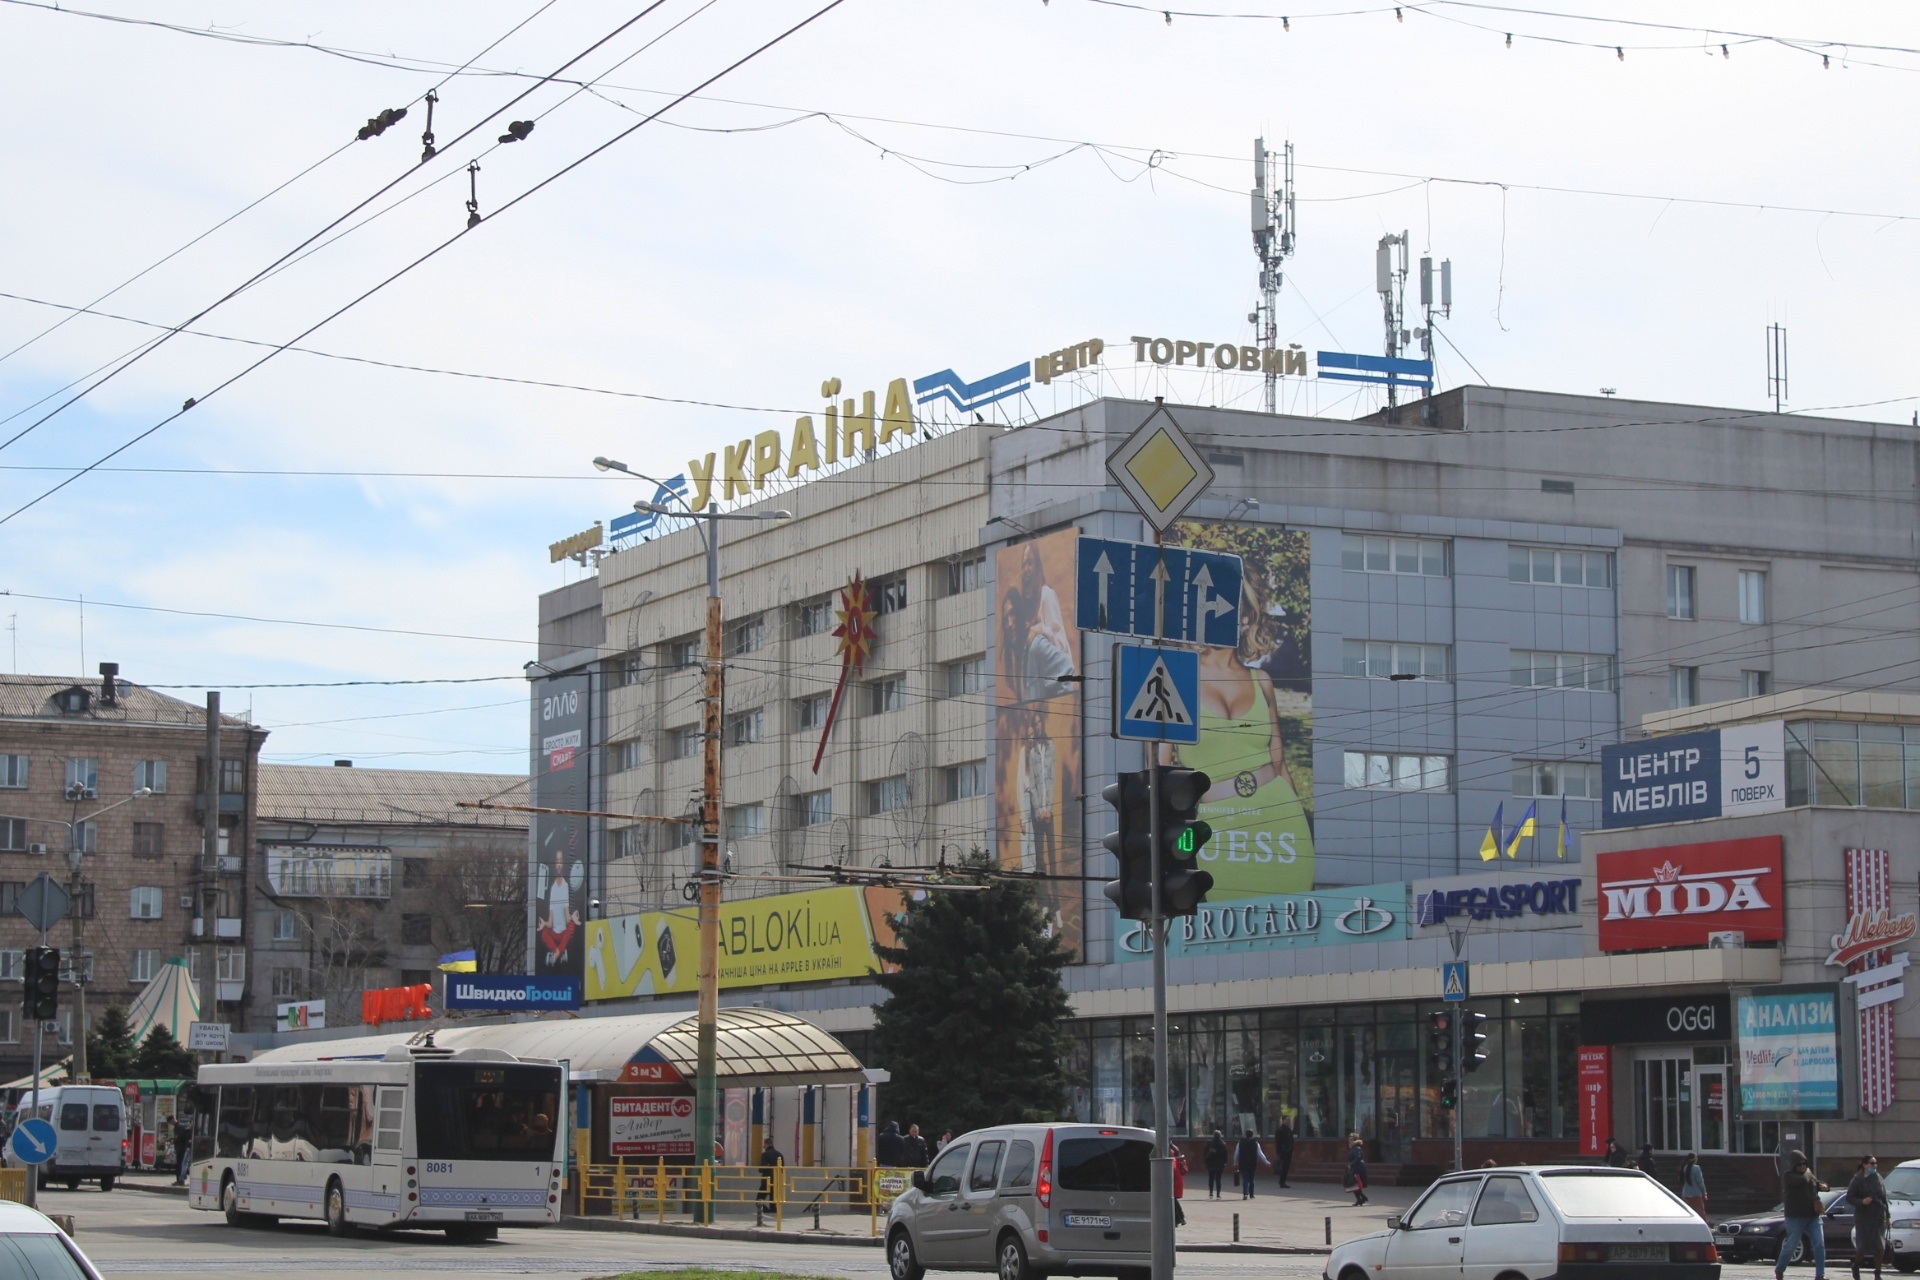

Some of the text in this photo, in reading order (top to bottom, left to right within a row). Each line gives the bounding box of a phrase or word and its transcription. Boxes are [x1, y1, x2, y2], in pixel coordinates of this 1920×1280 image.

[1130, 336, 1307, 376] ТОРГОВИЙ
[688, 377, 916, 512] УКРАЇНА
[1034, 338, 1104, 385] ЦЕНТР
[1619, 747, 1700, 784] ЦЕНТР
[1744, 746, 1761, 780] 5
[1612, 780, 1708, 814] МЕБЛІВ
[1731, 784, 1775, 803] ПОВЕРХ
[1200, 830, 1297, 864] UESS
[1434, 878, 1582, 924] MEGASPORT
[1602, 877, 1772, 921] MIDA
[1182, 898, 1320, 941] BROCARD
[1836, 910, 1915, 949] Melrose
[1667, 1005, 1715, 1032] OGGI
[1746, 1001, 1834, 1028] АНАЛІЗИ
[1746, 1049, 1775, 1064] Medlife
[613, 1102, 671, 1114] ВИТАДЕНТ
[426, 1162, 453, 1174] 8081
[535, 1166, 540, 1176] 1
